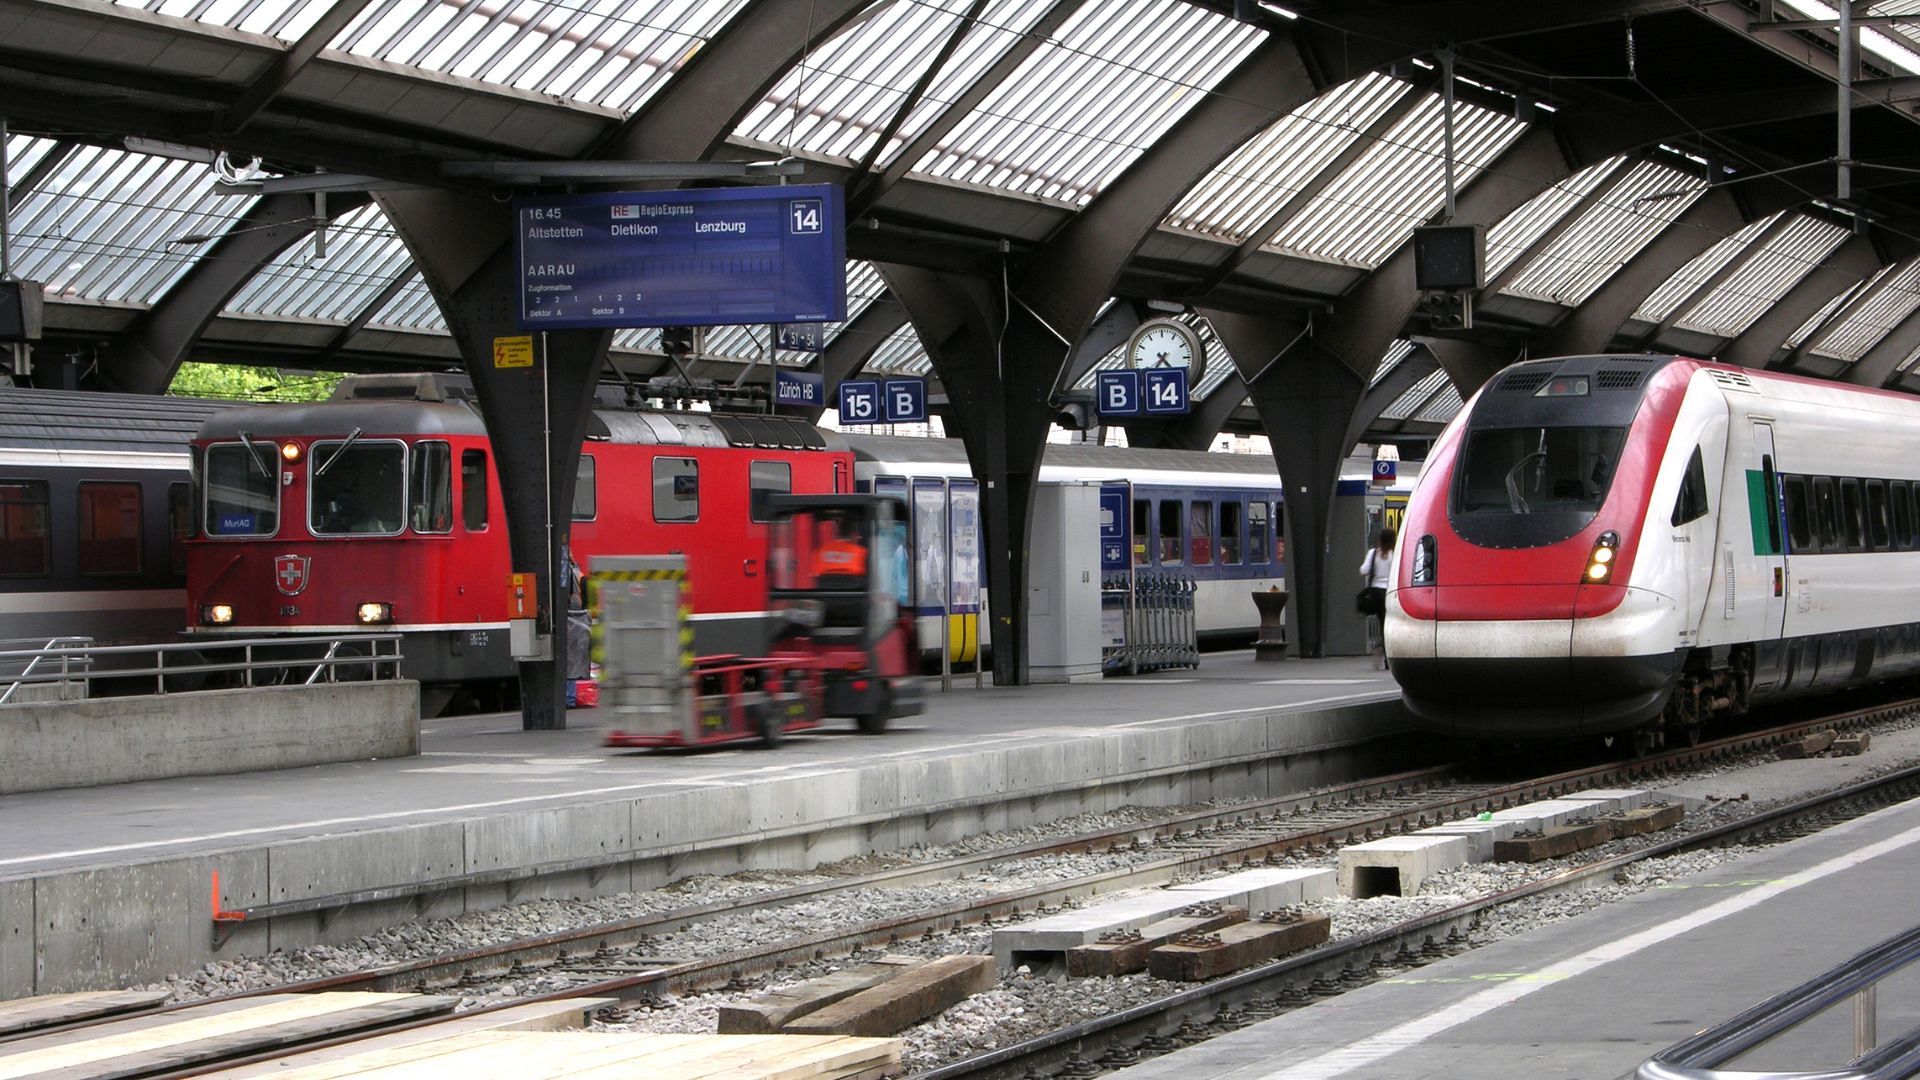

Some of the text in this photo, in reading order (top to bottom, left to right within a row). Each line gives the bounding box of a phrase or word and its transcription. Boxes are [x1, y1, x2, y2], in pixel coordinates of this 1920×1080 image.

[528, 208, 561, 220] 16.45
[613, 204, 695, 217] RE RegioExpress
[794, 209, 819, 231] 14
[528, 220, 747, 239] Altstetten Dietikon Lenzburg
[527, 264, 576, 277] AARAU
[528, 284, 573, 293] Zugformation
[617, 294, 623, 302] 2
[530, 307, 625, 318] Sektor A Sektor B
[779, 381, 814, 400] Zürich HB
[1109, 384, 1127, 408] B
[1151, 382, 1179, 406] 14
[846, 394, 872, 417] 15
[896, 393, 914, 416] B
[1270, 501, 1276, 519] 2
